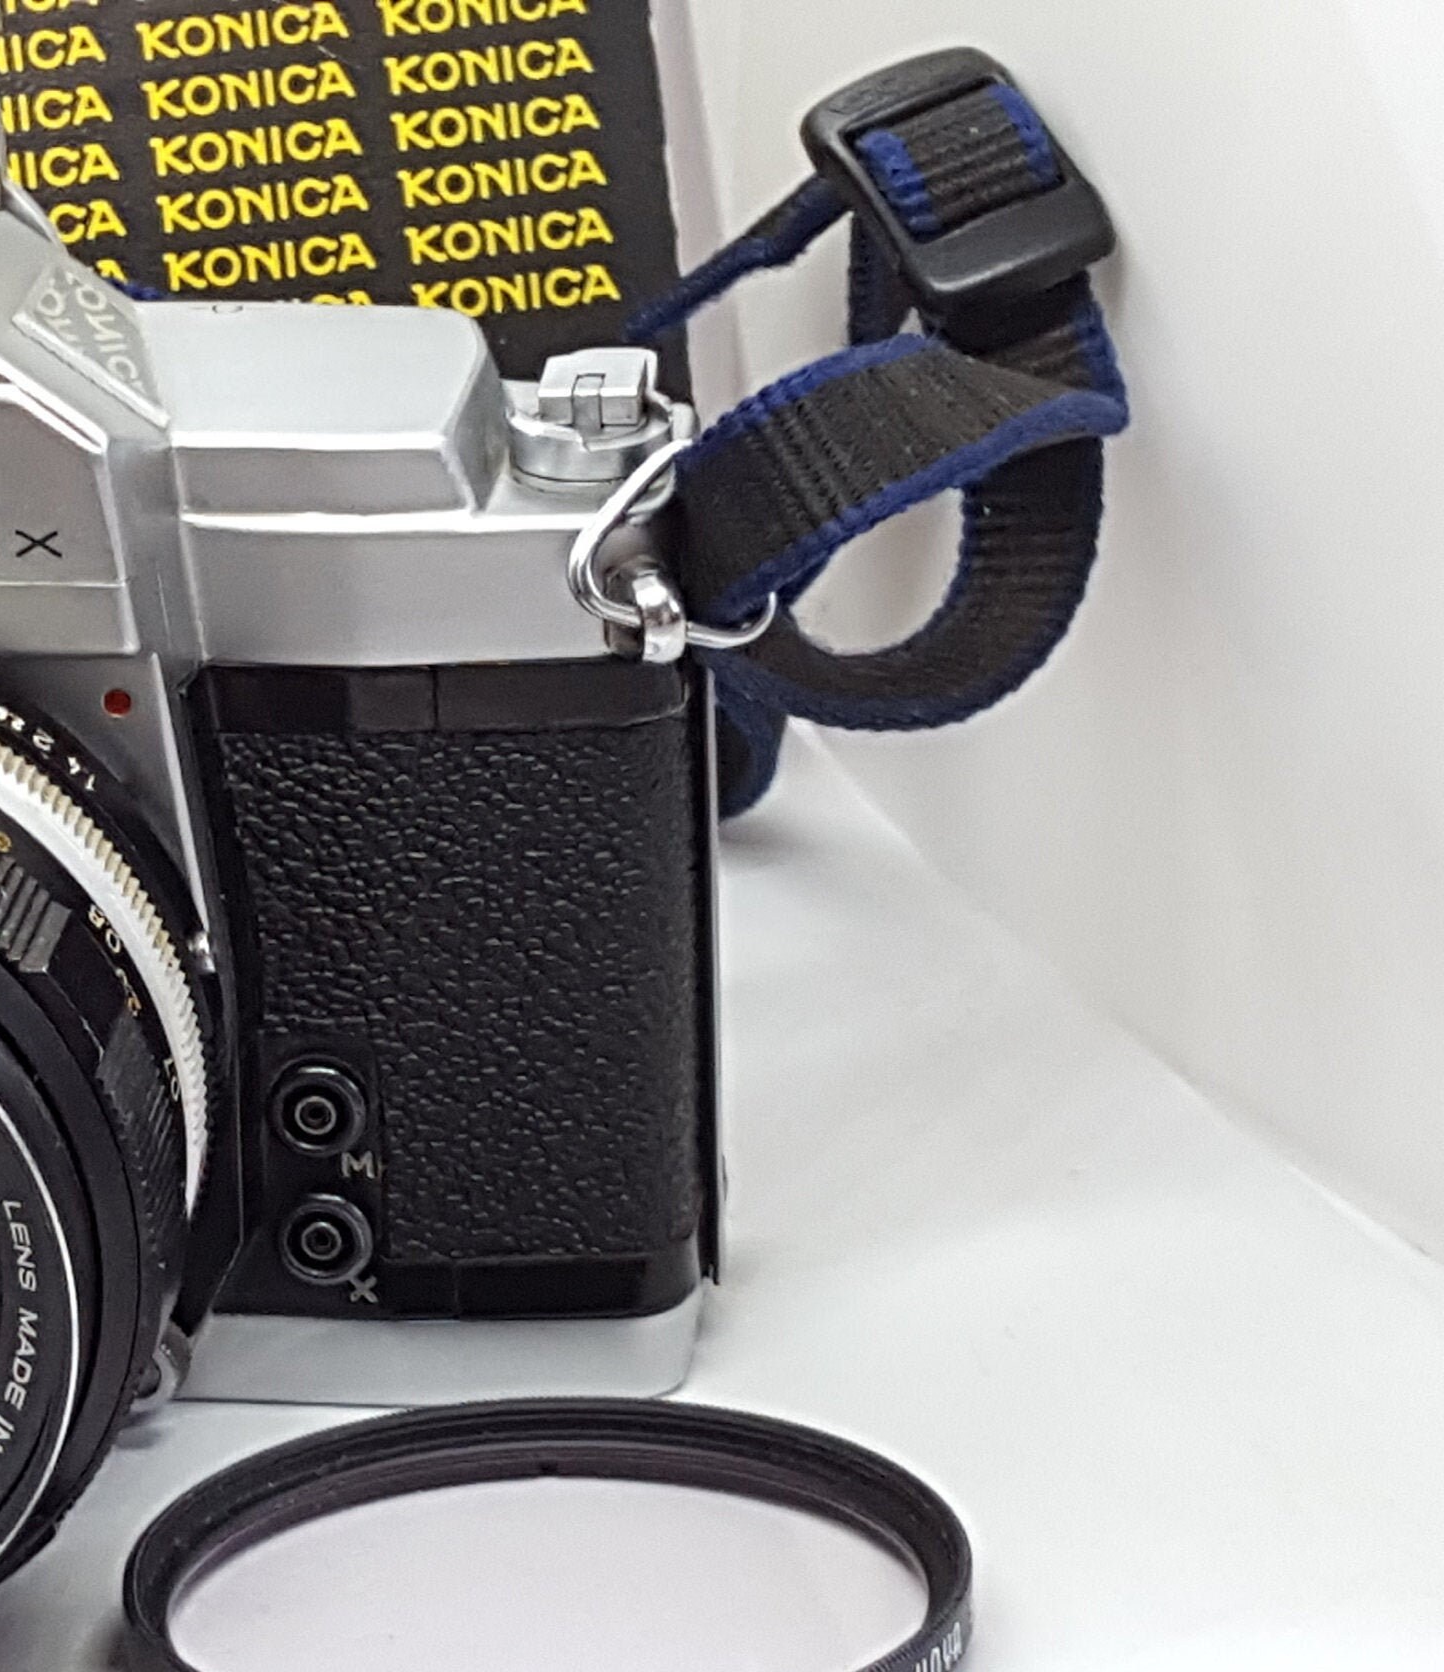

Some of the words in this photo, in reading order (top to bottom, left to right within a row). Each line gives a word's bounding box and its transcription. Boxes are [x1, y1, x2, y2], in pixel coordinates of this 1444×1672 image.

[135, 1, 351, 61] KONICA
[143, 60, 358, 120] KONICA
[383, 37, 594, 95] KONICA
[150, 117, 364, 177] KONICA
[389, 93, 602, 152] KONICA
[156, 173, 371, 234] KONICA
[397, 149, 608, 209] KONICA
[163, 232, 378, 291] KONICA
[404, 207, 615, 265] KONICA
[411, 264, 622, 318] KONICA
[31, 727, 55, 753] 2
[340, 1150, 375, 1180] M
[0, 1199, 38, 1293] LENS
[2, 1306, 39, 1411] MADE
[916, 1621, 963, 1672] OYA
